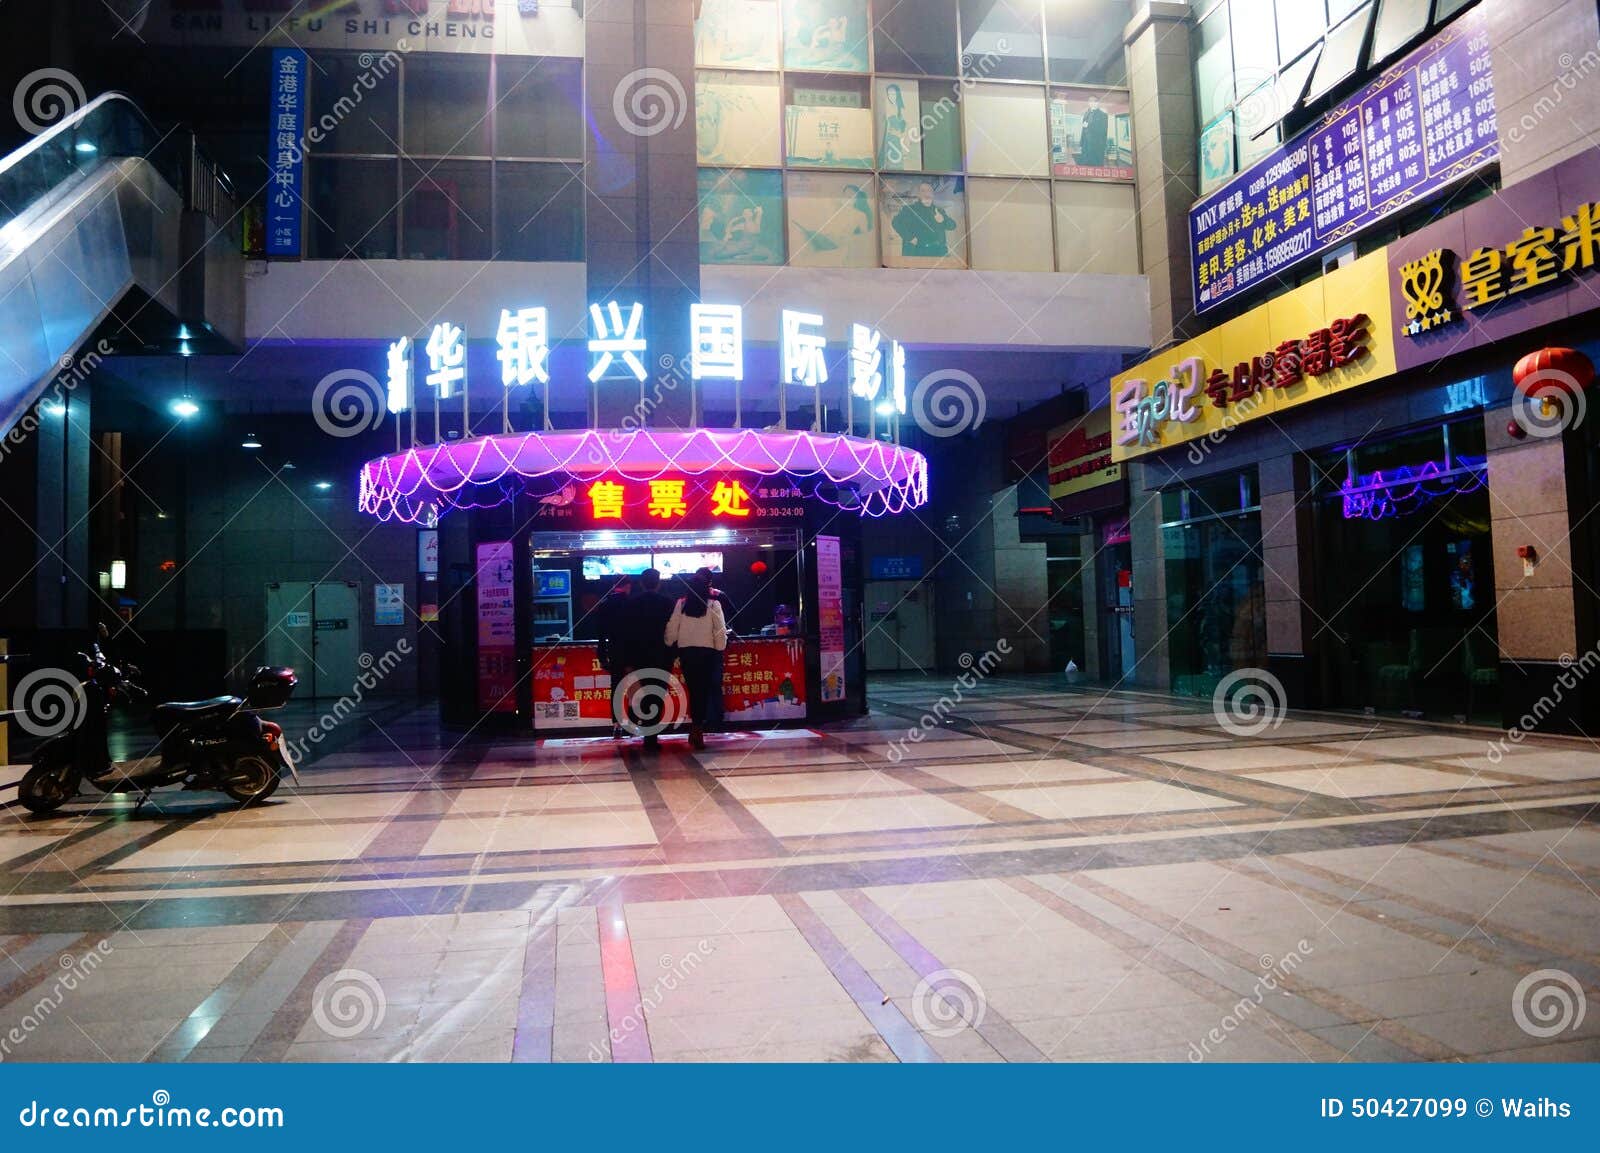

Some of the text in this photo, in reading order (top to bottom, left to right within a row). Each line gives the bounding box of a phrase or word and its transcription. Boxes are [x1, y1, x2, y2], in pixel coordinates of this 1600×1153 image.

[345, 19, 390, 35] SHI
[407, 21, 494, 39] CHENG
[587, 480, 750, 518] 售票处
[757, 507, 804, 516] 09:30-24:00
